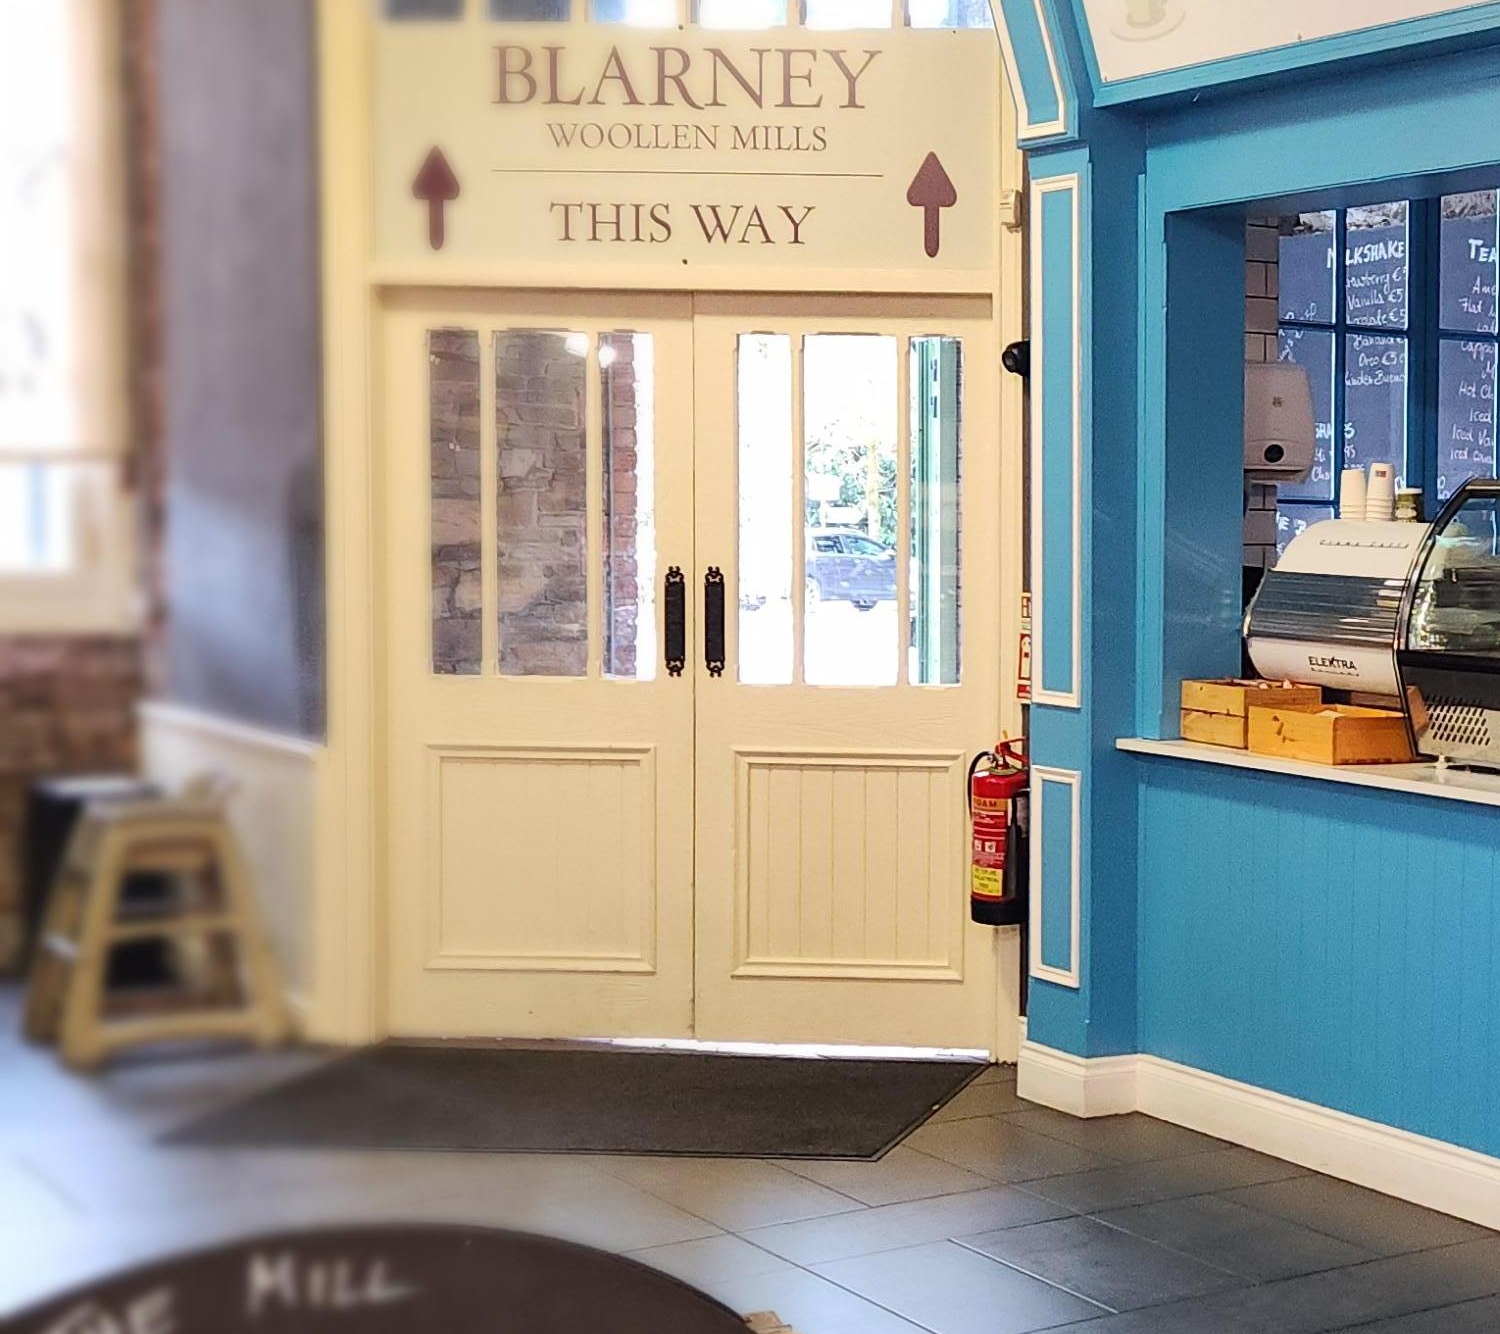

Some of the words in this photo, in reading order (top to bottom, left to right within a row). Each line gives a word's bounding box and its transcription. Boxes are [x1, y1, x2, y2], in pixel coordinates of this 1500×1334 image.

[490, 42, 883, 111] BLARNEY
[545, 120, 720, 152] WOOLLEN
[729, 123, 828, 153] MILLS
[548, 200, 672, 245] THIS
[690, 203, 817, 246] WAY
[246, 1252, 422, 1317] MILL
